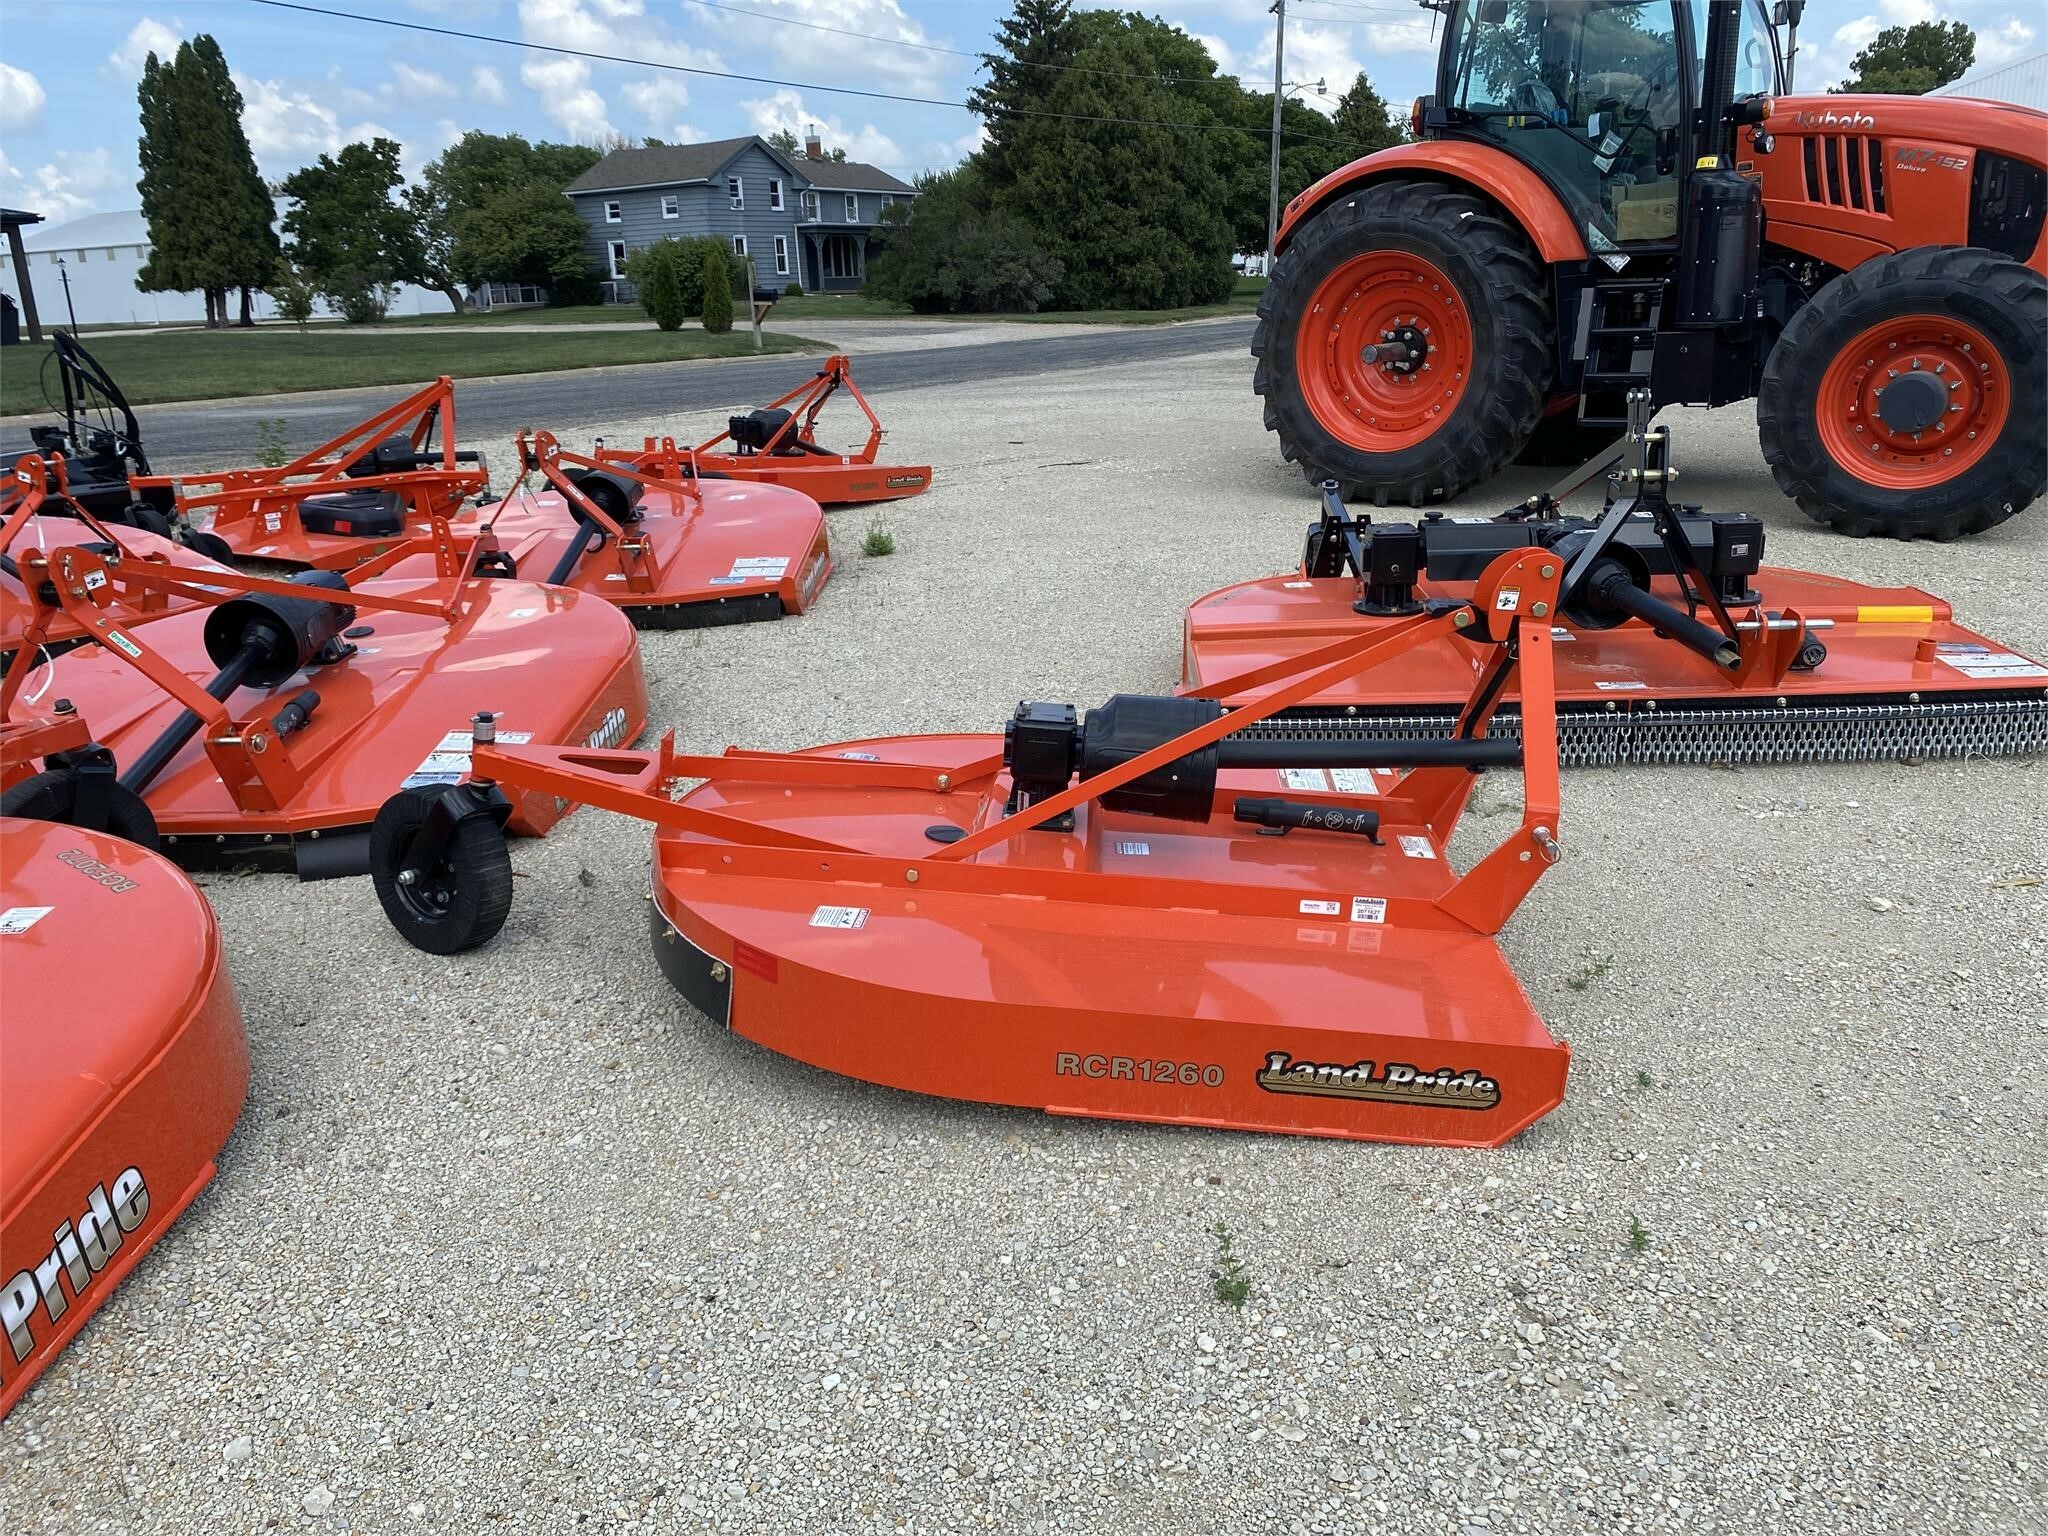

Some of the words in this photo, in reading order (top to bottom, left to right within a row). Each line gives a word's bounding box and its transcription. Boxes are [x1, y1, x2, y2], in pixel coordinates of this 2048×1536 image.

[1795, 110, 1875, 130] Kubota
[1894, 147, 1968, 171] M7-152
[1896, 163, 1927, 173] Deluxe
[57, 848, 140, 894] RCF2072
[1056, 1052, 1225, 1088] RCR1260
[1262, 1053, 1374, 1088] Land
[1382, 1064, 1497, 1099] Pride
[0, 1166, 151, 1365] Pride
